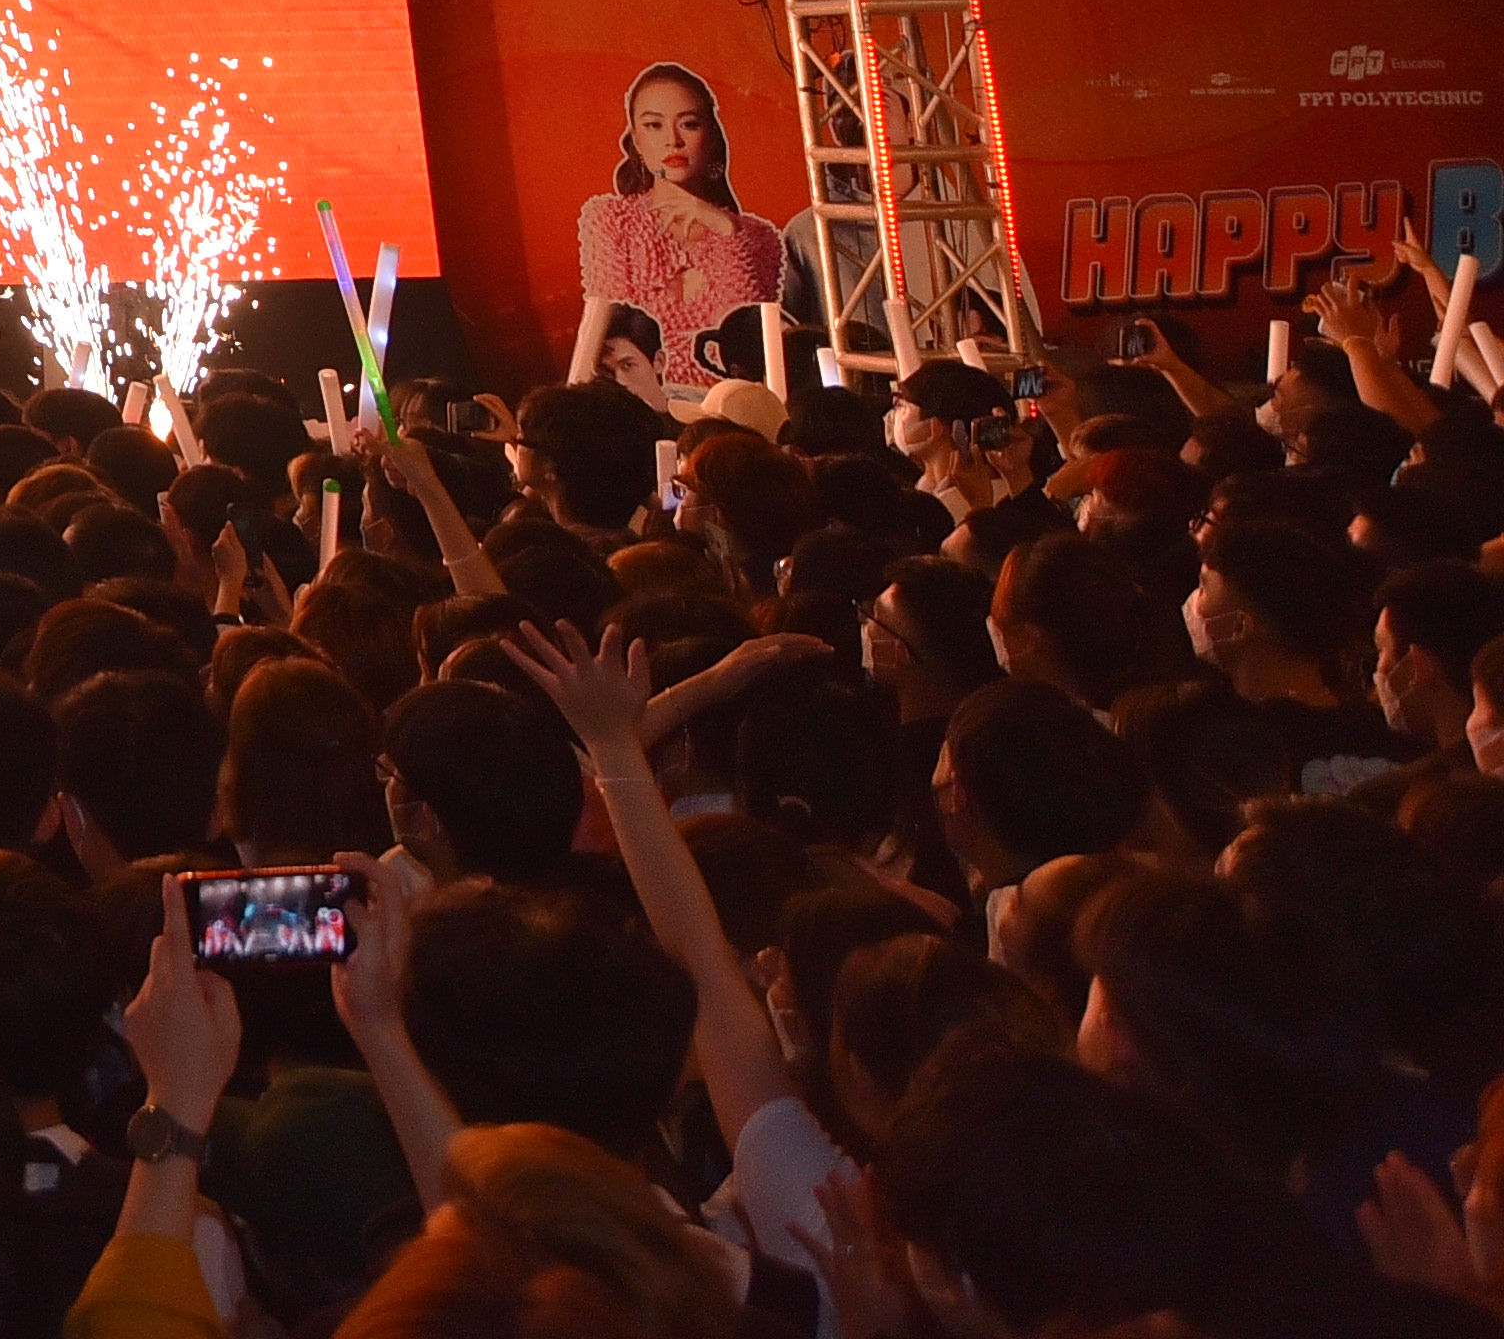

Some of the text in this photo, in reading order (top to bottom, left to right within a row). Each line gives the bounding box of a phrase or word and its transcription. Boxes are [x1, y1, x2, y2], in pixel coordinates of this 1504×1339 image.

[1298, 89, 1484, 107] FPT POLYTECHNIC
[1061, 180, 1402, 304] HAPPY
